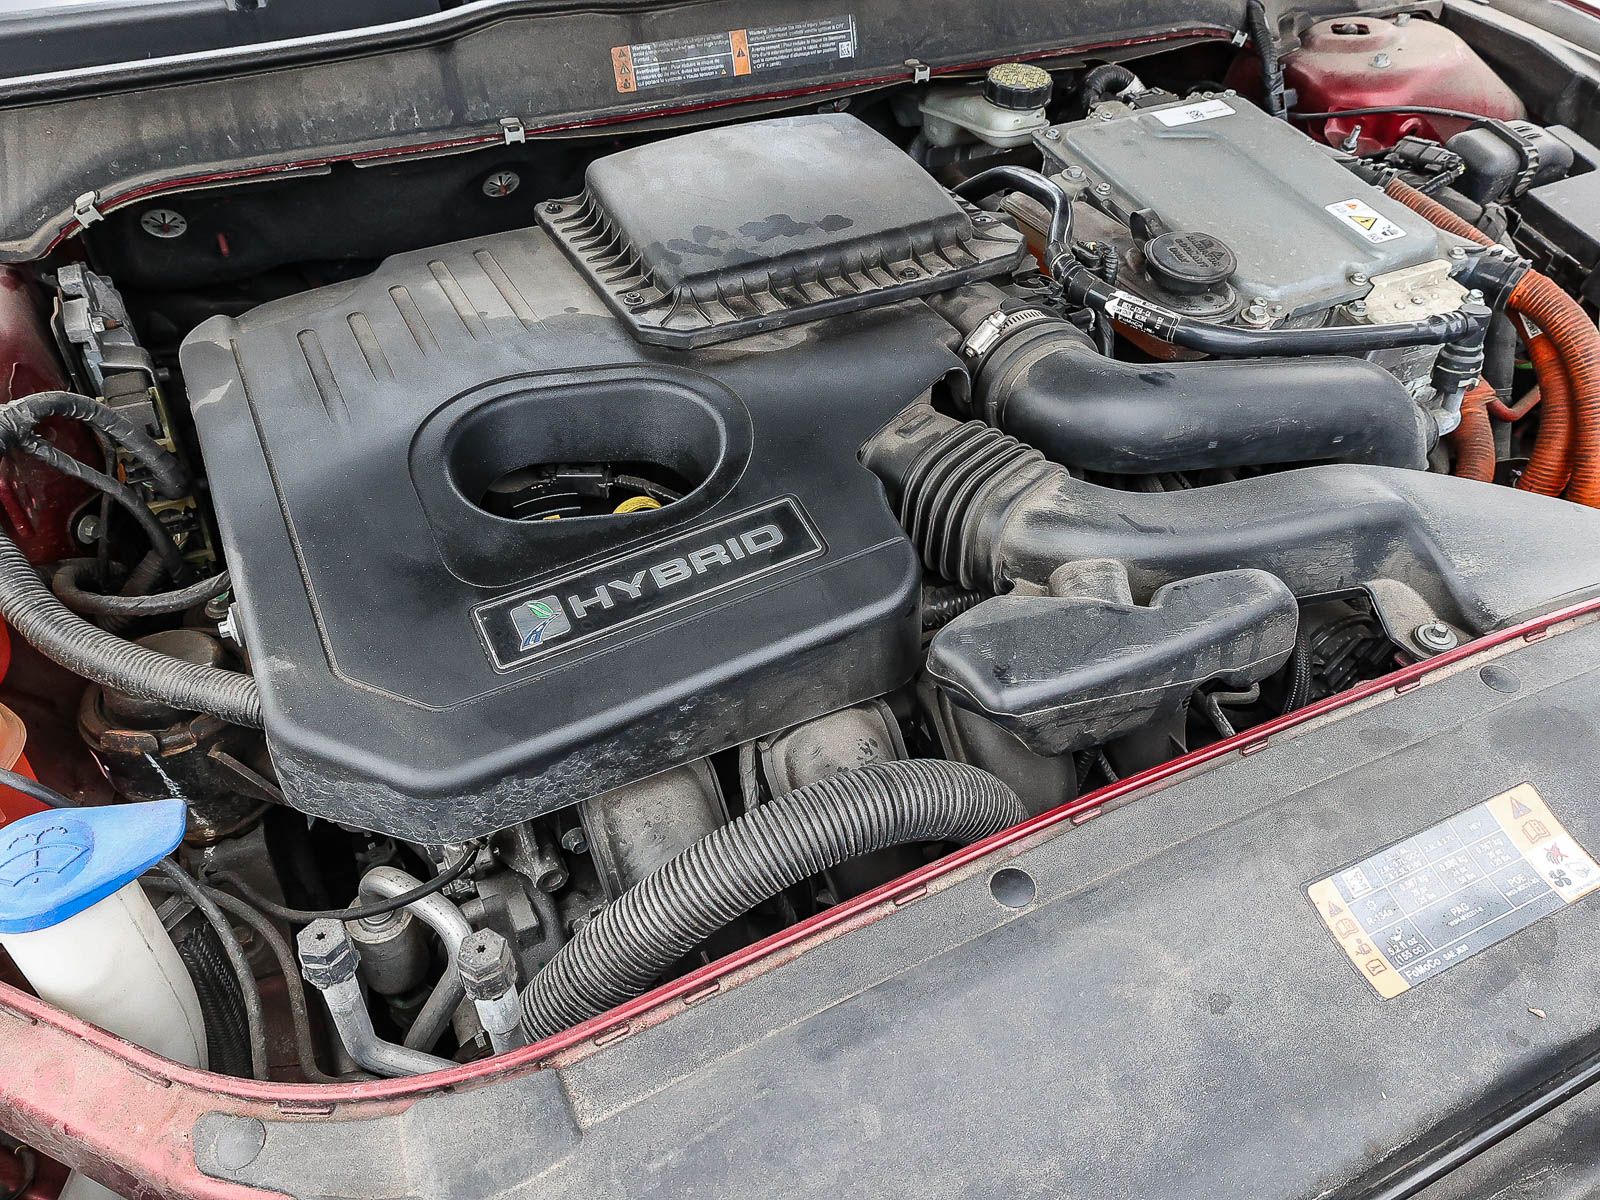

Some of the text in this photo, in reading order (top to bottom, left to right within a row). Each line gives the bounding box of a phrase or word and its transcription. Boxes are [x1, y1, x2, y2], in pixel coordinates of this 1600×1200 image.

[567, 524, 784, 619] HYBRID
[1450, 902, 1469, 916] PAG
[1404, 955, 1441, 979] FoMoCo
